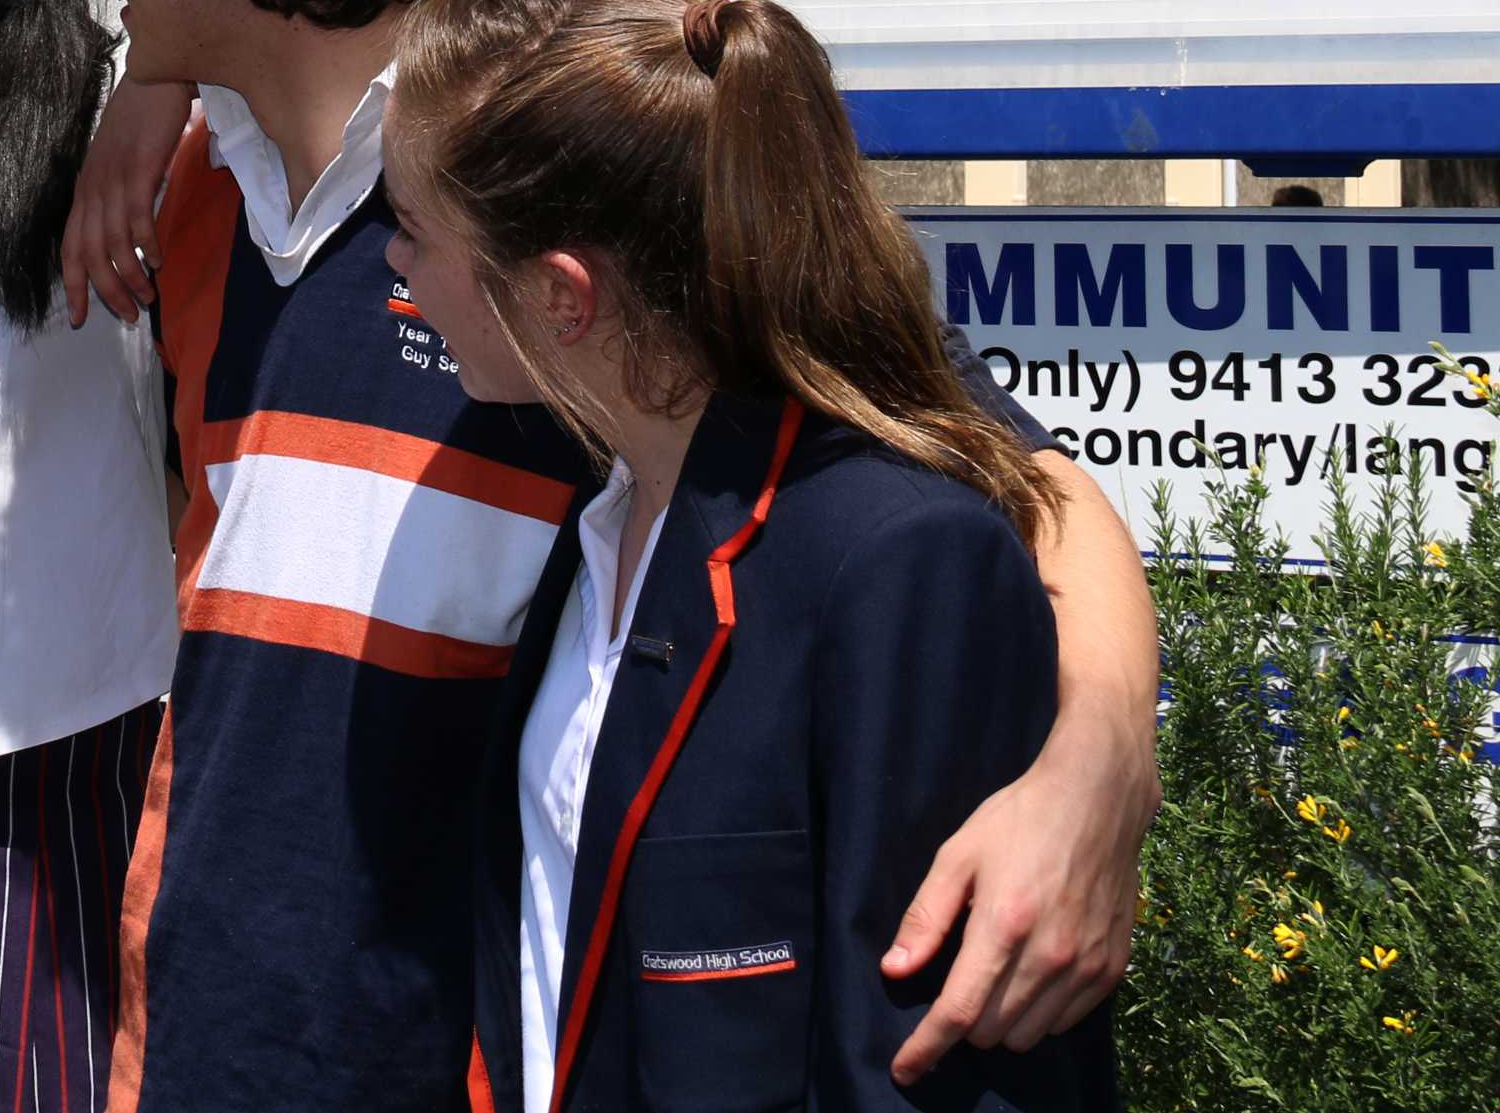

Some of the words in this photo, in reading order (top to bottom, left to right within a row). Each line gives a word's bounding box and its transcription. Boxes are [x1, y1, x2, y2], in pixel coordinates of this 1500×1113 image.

[945, 242, 1495, 334] MMUNIT
[397, 321, 431, 344] Year
[401, 345, 431, 369] Guy
[1168, 351, 1336, 405] 9413
[1362, 353, 1500, 410] 323
[642, 954, 702, 970] Chatswood
[705, 954, 737, 970] High
[739, 945, 790, 964] School
